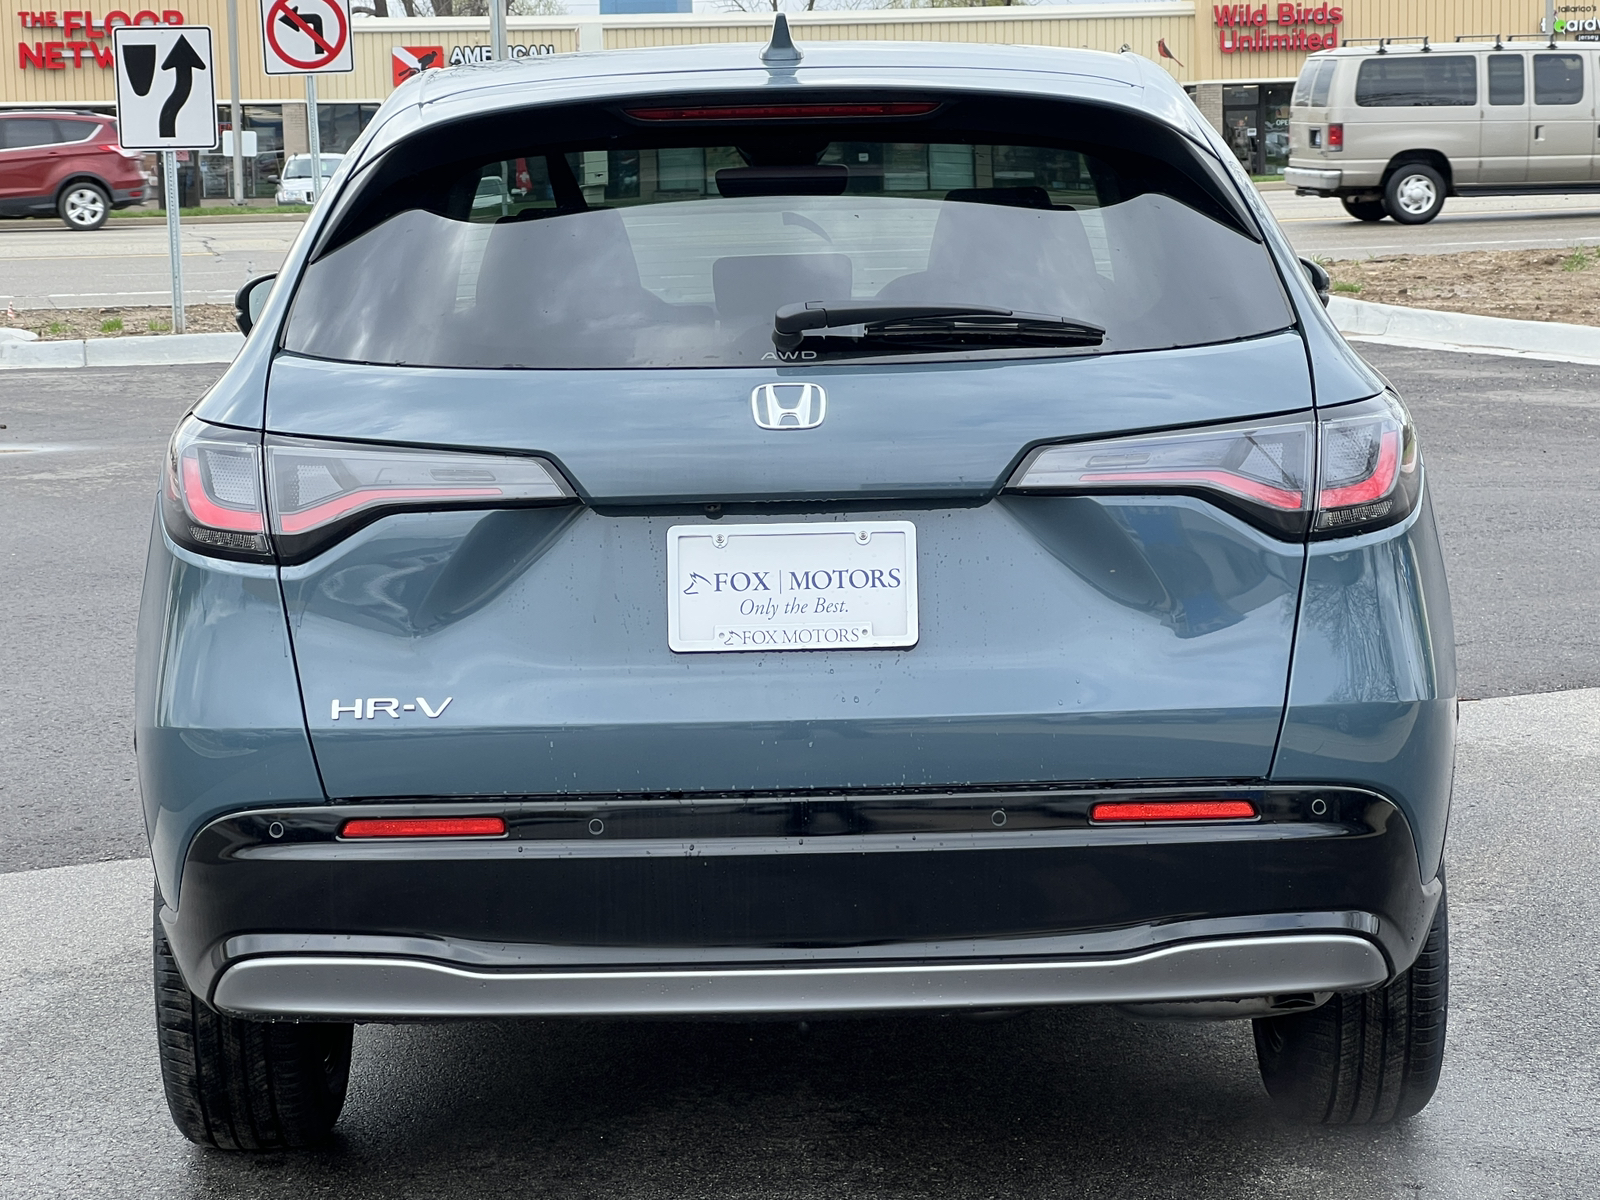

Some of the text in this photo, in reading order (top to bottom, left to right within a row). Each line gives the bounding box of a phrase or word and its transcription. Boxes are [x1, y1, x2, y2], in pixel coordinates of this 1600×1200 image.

[17, 11, 58, 28] THE
[1213, 2, 1343, 27] Wild Birds
[1220, 27, 1337, 54] Unlimited
[18, 41, 114, 69] NETW
[450, 44, 555, 66] AMEICA
[1275, 119, 1290, 127] OPE
[761, 350, 817, 361] AWD
[713, 567, 901, 592] FOX MOTORS
[739, 596, 849, 620] Only the Best.
[742, 627, 860, 645] FOX MOTORS
[331, 696, 453, 720] HR-V
